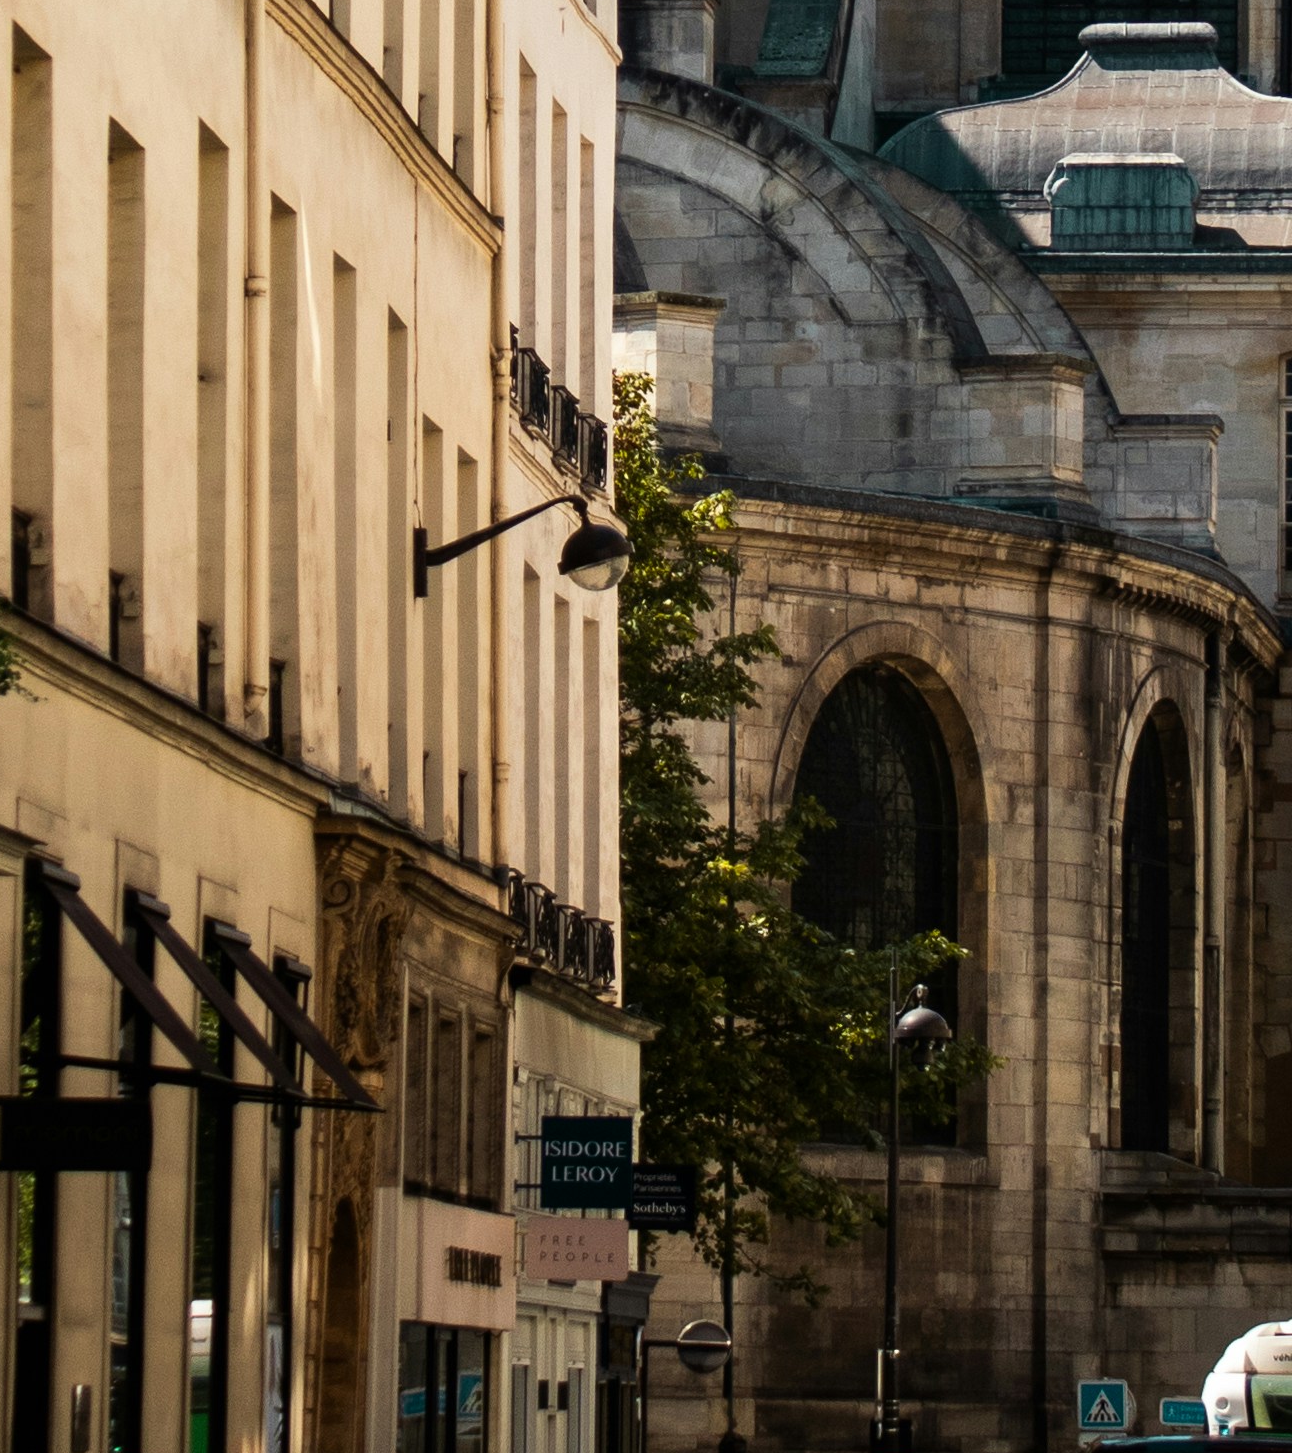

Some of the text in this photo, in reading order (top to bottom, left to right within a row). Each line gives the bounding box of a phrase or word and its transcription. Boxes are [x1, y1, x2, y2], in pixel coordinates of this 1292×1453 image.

[544, 1139, 627, 1158] ISIDORE
[551, 1165, 619, 1183] LEROY
[633, 1201, 686, 1216] Sotheby's
[540, 1235, 585, 1246] FREE
[540, 1251, 615, 1263] PEOPLE
